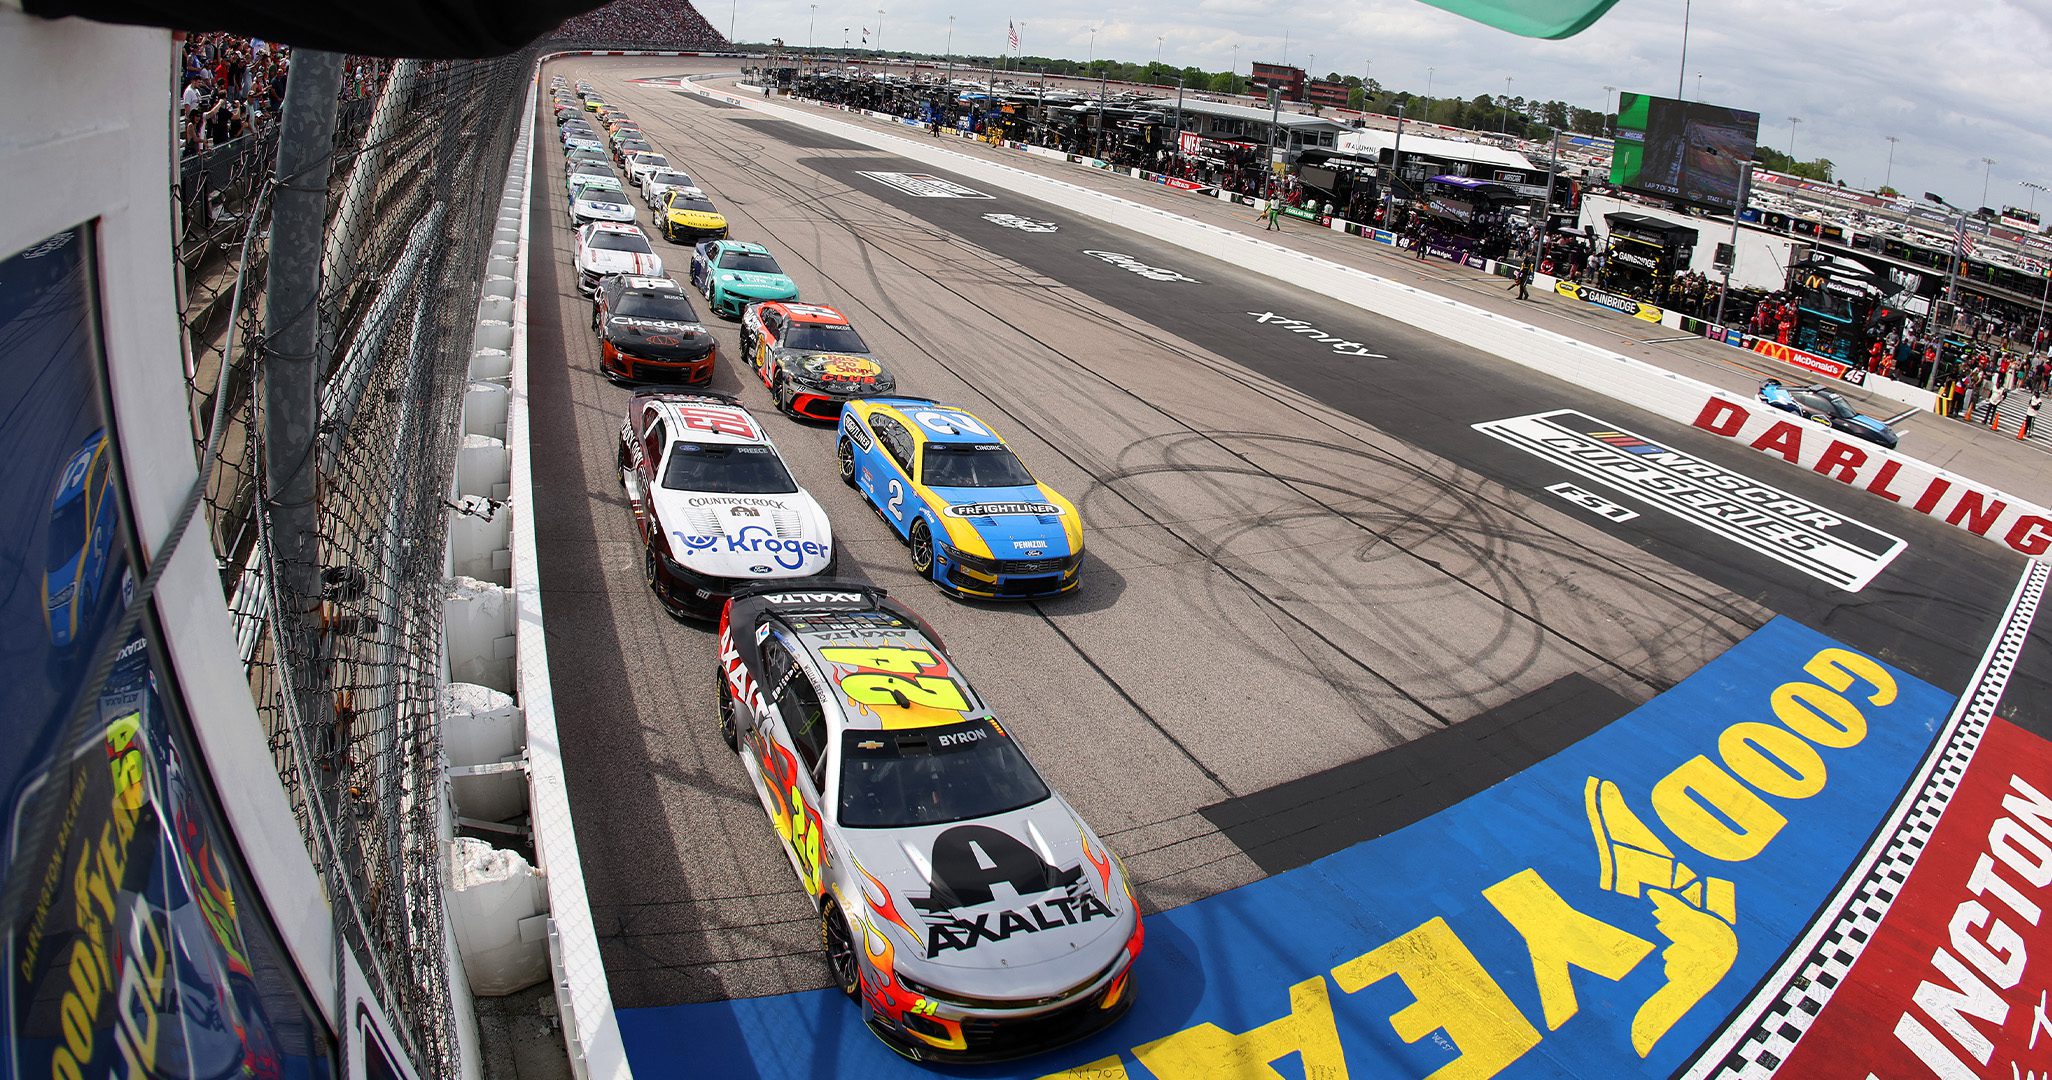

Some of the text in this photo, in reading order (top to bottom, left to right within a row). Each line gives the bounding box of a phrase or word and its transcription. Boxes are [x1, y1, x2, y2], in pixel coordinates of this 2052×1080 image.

[1351, 145, 1376, 154] ALUMNI
[1399, 238, 1410, 248] 48
[1618, 251, 1656, 270] GAINBRIDGE
[1827, 282, 1864, 298] McDonald's
[1588, 290, 1637, 316] GAINBRIDGE
[1248, 311, 1388, 359] xfinity
[1792, 353, 1839, 375] McDonald's
[821, 373, 876, 384] CLUB
[1844, 369, 1863, 384] 45
[914, 411, 991, 437] 2
[1541, 437, 1651, 474] CUP
[1693, 396, 2052, 555] DARLING
[888, 479, 904, 521] 2
[1639, 451, 1842, 531] NASCAR
[688, 497, 788, 511] COUNTRY CROCK
[958, 503, 1055, 516] FREIGHTLINER
[1556, 486, 1630, 521] FS1
[1640, 478, 1827, 552] SERIES
[727, 525, 829, 570] Kroger
[1013, 540, 1048, 550] PENNZOIL
[763, 592, 862, 604] AXALTA
[812, 630, 907, 641] AXALTA
[818, 645, 974, 713] 24
[938, 727, 988, 747] BYRON
[791, 786, 821, 896] 24
[927, 897, 1116, 960] AXALTA
[1865, 773, 2052, 1080] INGTON
[911, 998, 938, 1017] 24
